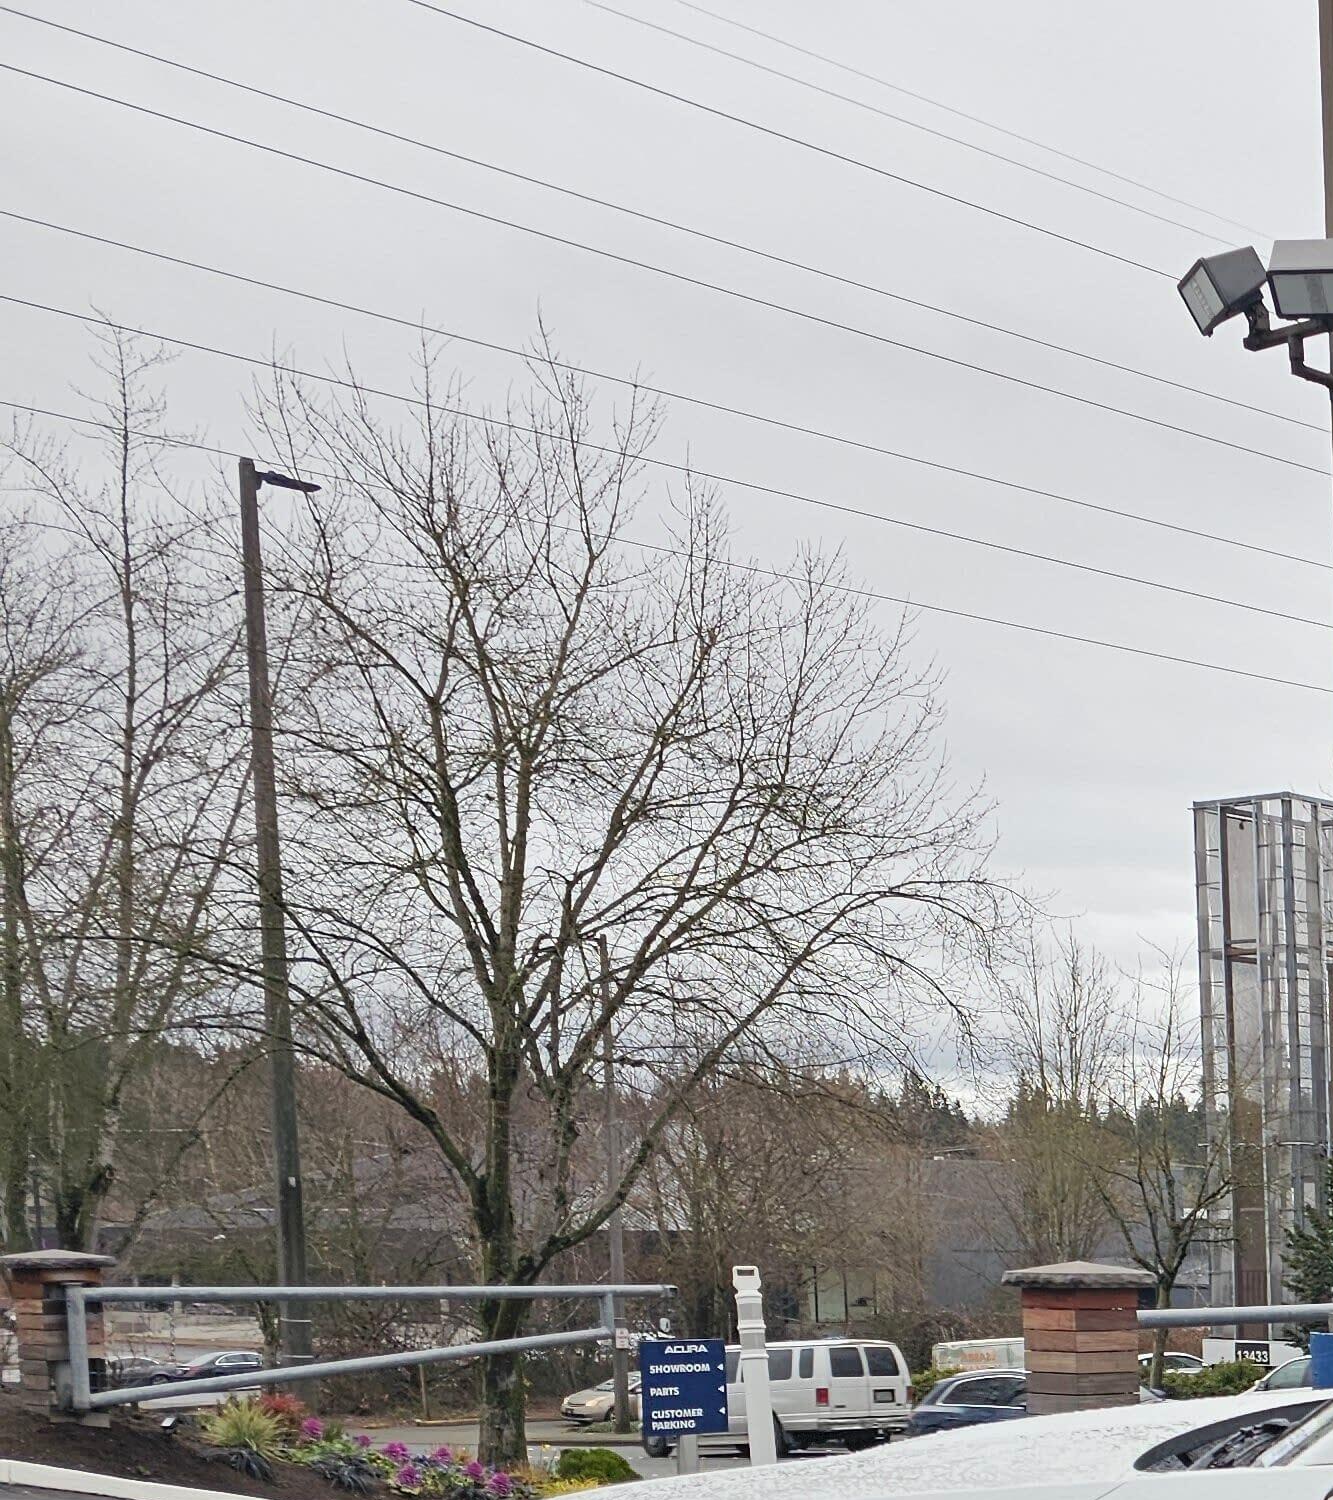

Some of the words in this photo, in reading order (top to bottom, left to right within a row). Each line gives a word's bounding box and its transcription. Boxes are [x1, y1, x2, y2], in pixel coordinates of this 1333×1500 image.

[664, 1344, 708, 1354] ACURA
[649, 1363, 710, 1374] SHOWROOM
[650, 1387, 680, 1396] PARTS
[651, 1408, 703, 1419] CUSTOMER
[651, 1419, 696, 1430] PARKING
